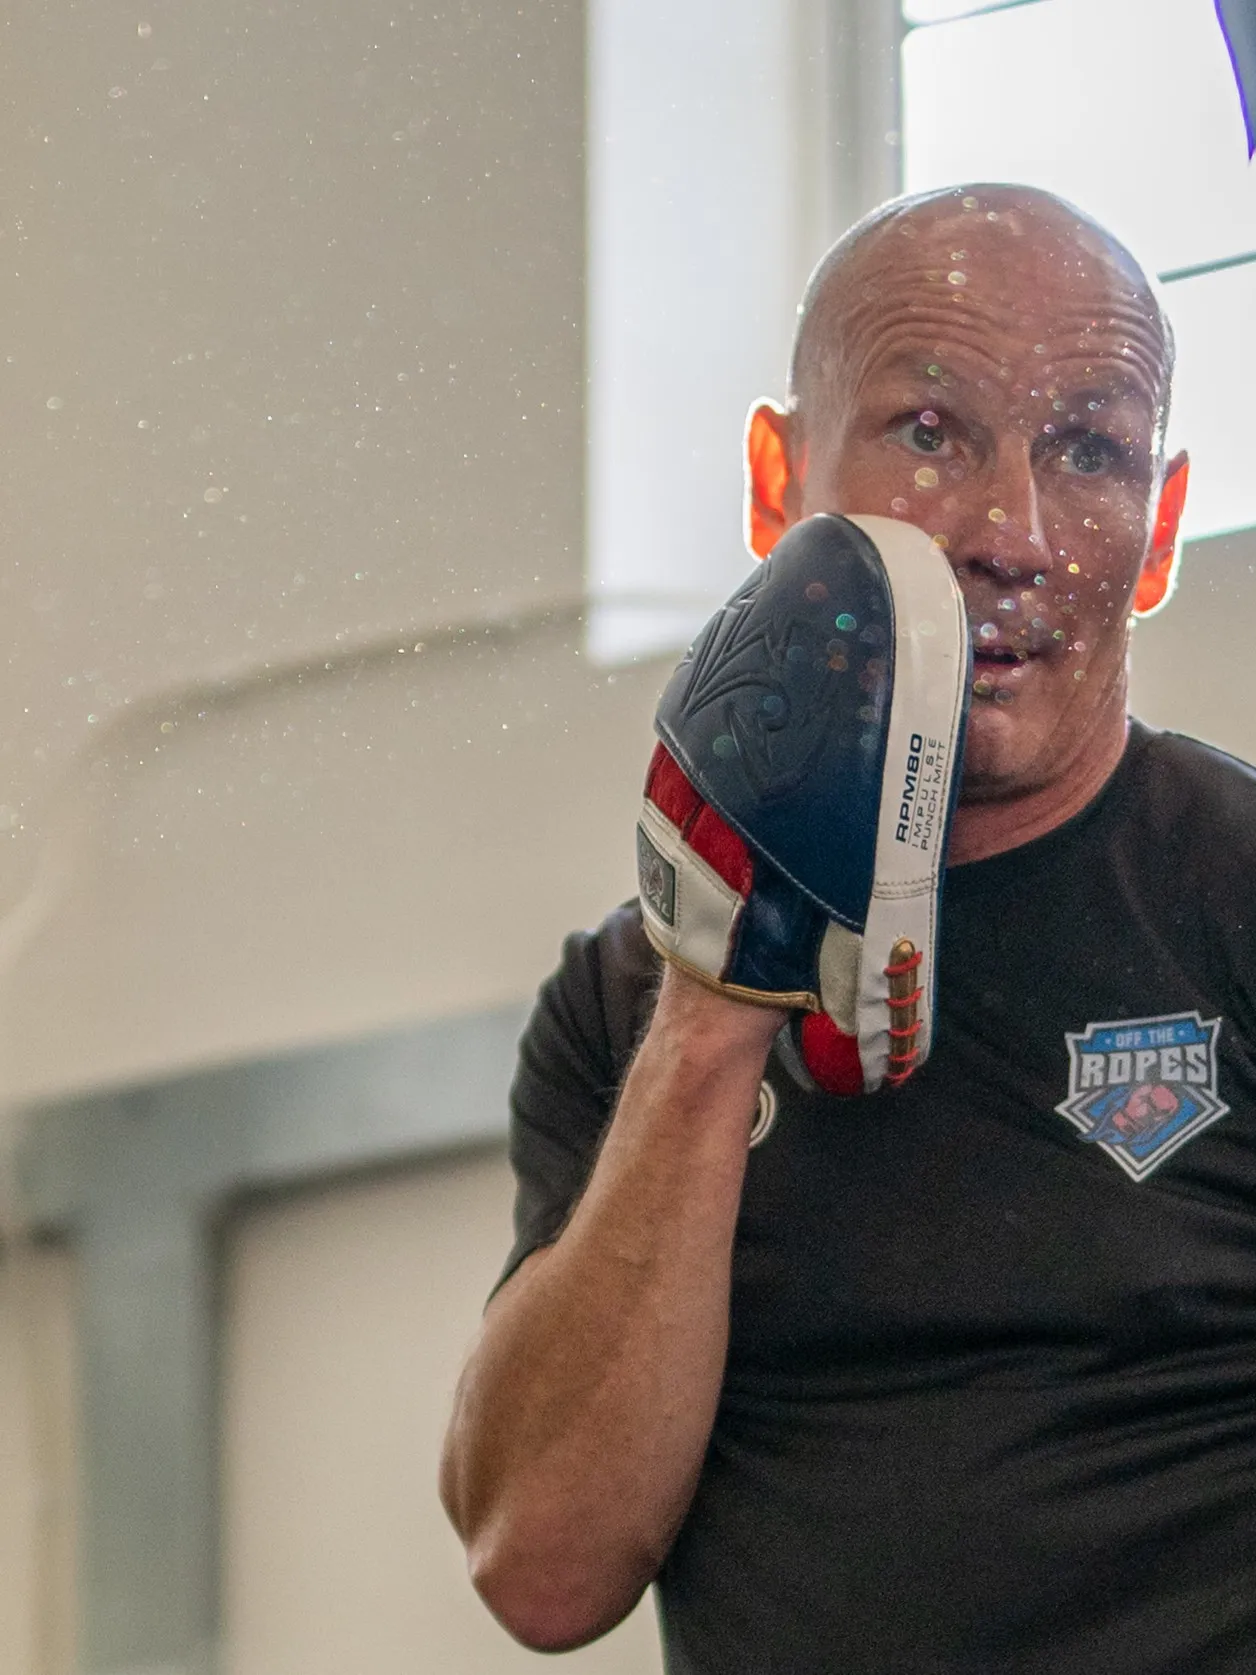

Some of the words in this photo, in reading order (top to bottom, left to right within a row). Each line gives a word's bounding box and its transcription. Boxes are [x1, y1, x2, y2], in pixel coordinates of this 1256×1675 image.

[895, 733, 923, 843] RPM80
[912, 737, 937, 848] IMPULSE
[920, 790, 939, 851] PUNCH
[933, 741, 946, 785] MITT
[1079, 1043, 1208, 1088] ROPES
[1115, 1031, 1142, 1048] OFF
[1148, 1027, 1175, 1044] THE
